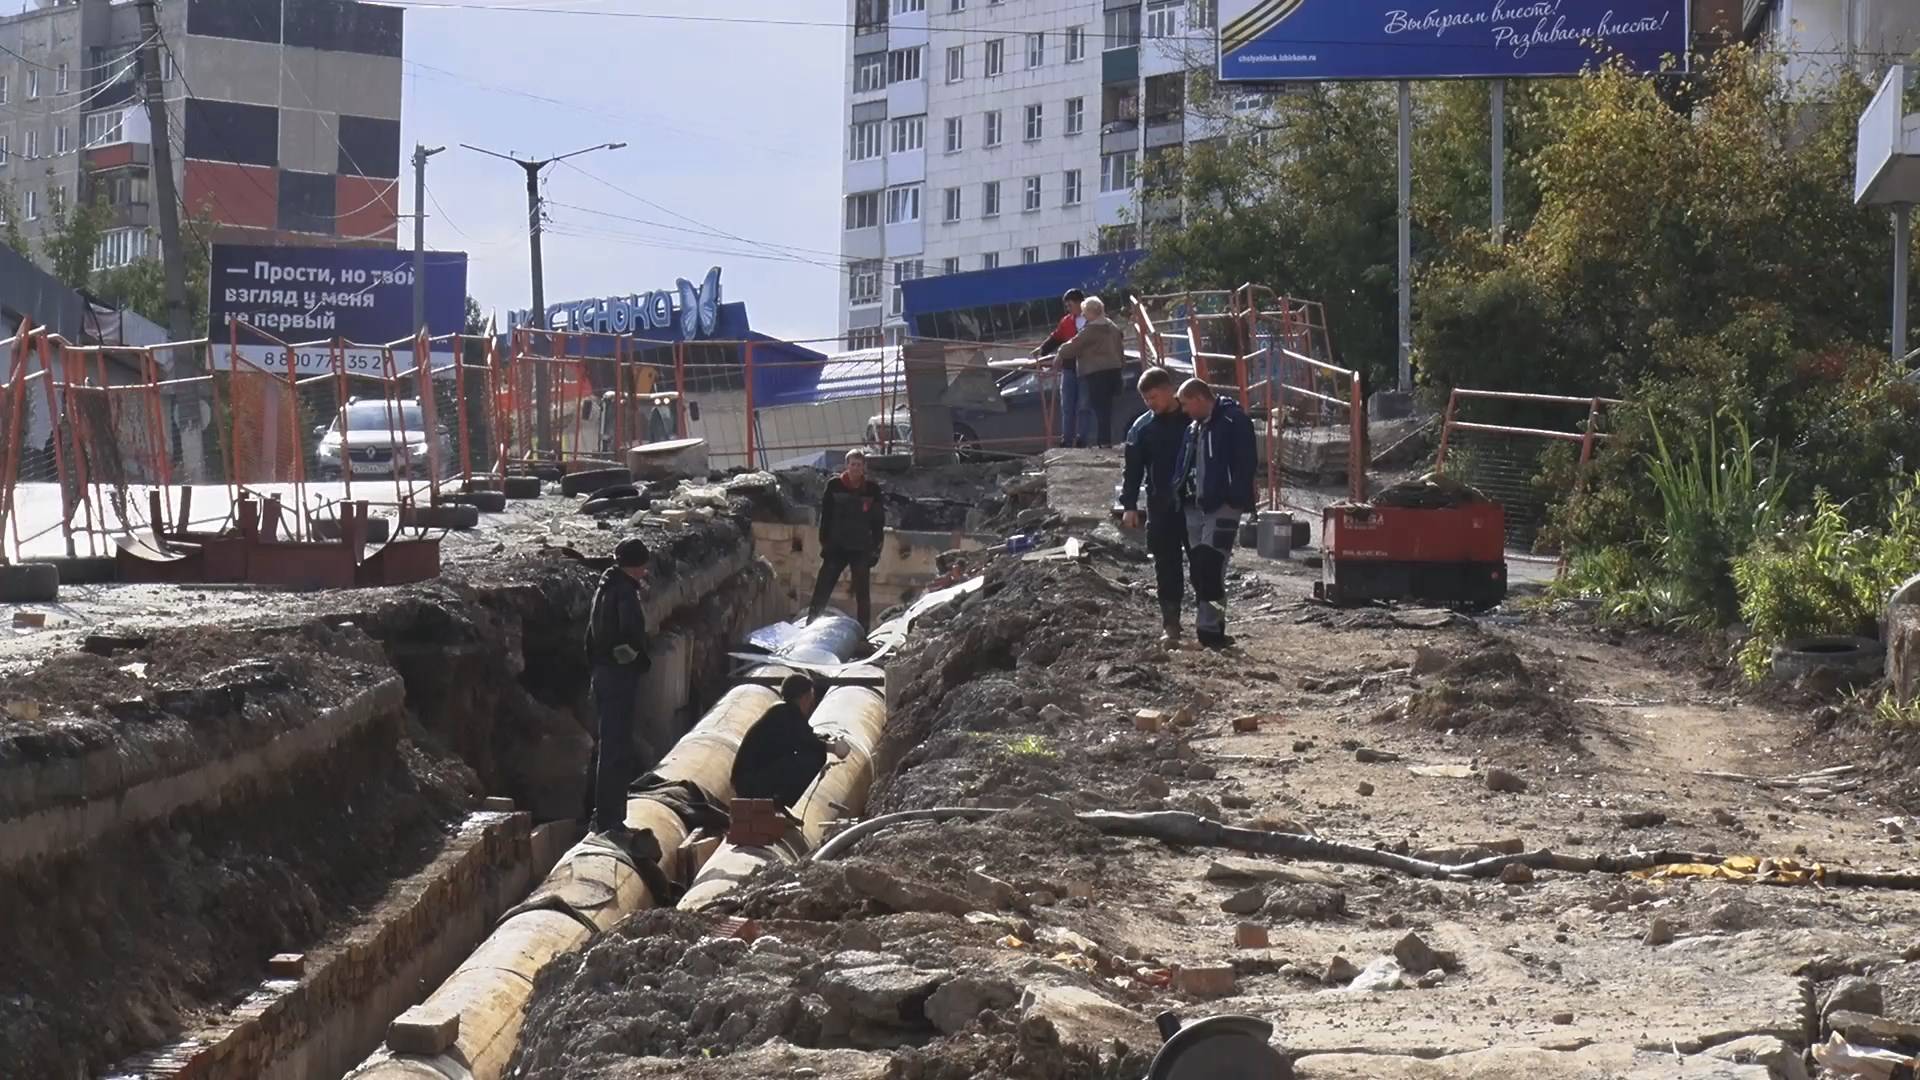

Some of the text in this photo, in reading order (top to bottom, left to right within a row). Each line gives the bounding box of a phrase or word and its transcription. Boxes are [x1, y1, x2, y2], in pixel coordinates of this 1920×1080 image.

[1384, 0, 1561, 38] Выбираем вместе!
[1491, 10, 1669, 59] Развиваем вместе!
[254, 260, 336, 286] Прости,
[341, 268, 366, 283] но
[225, 288, 375, 309] взгляд у меня
[254, 310, 336, 333] первый
[264, 352, 275, 366] 8
[348, 355, 368, 369] 35
